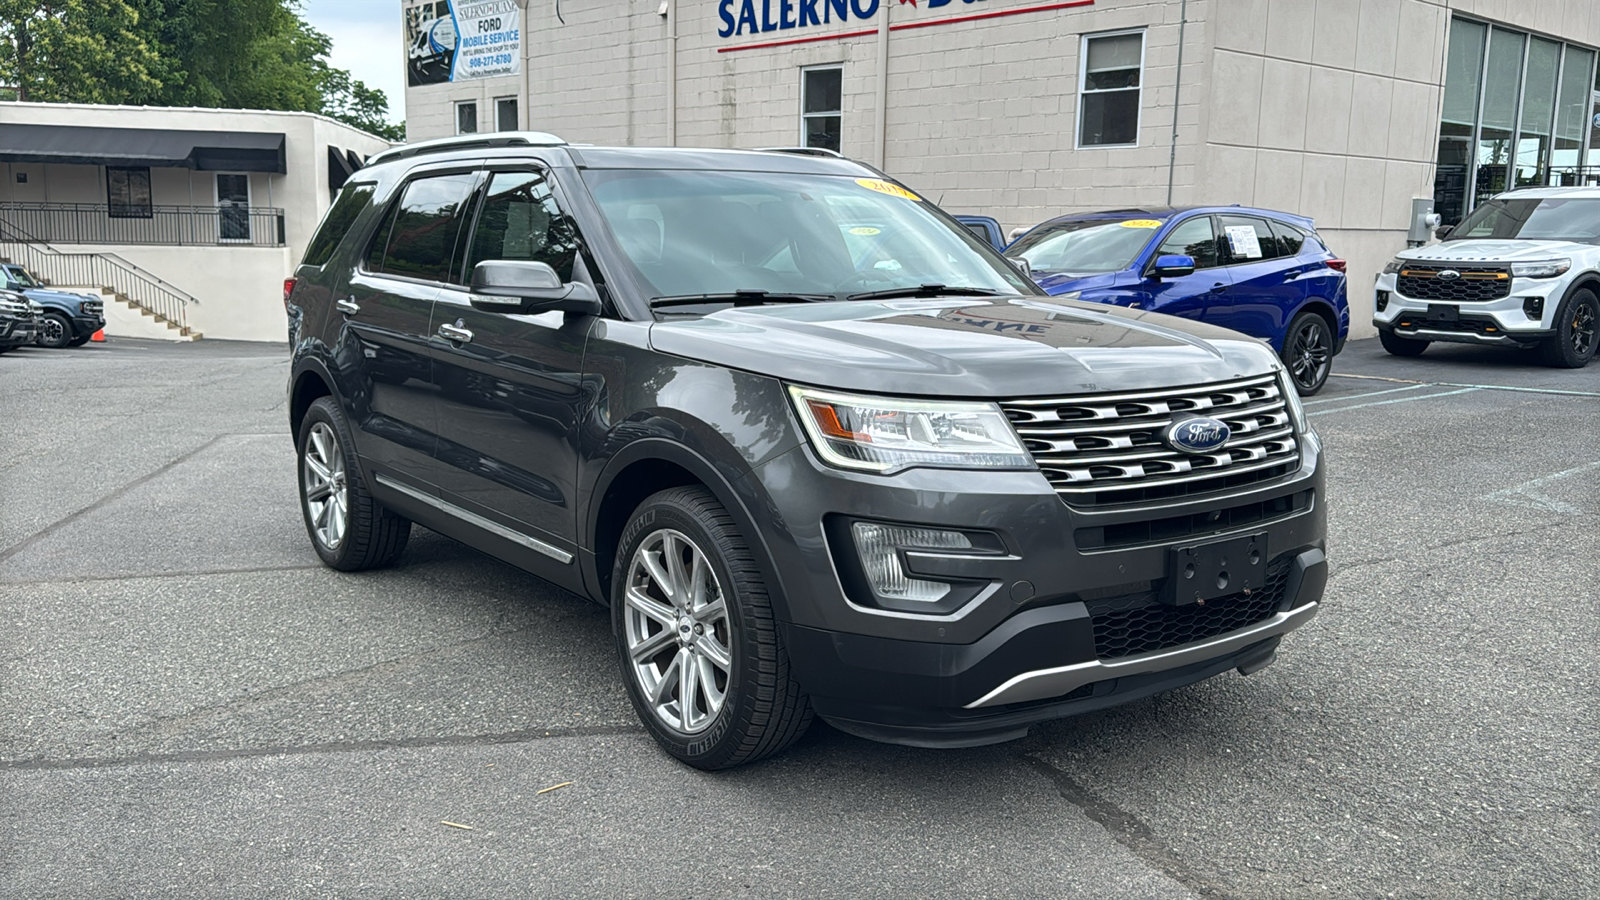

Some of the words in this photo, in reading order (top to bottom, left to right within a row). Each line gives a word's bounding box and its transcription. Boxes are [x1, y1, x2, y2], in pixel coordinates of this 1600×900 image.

[478, 17, 502, 33] FORD
[462, 34, 488, 48] MOBILE
[489, 29, 519, 44] SERVICE
[1189, 422, 1221, 444] Ford
[687, 701, 735, 756] MICHELIN
